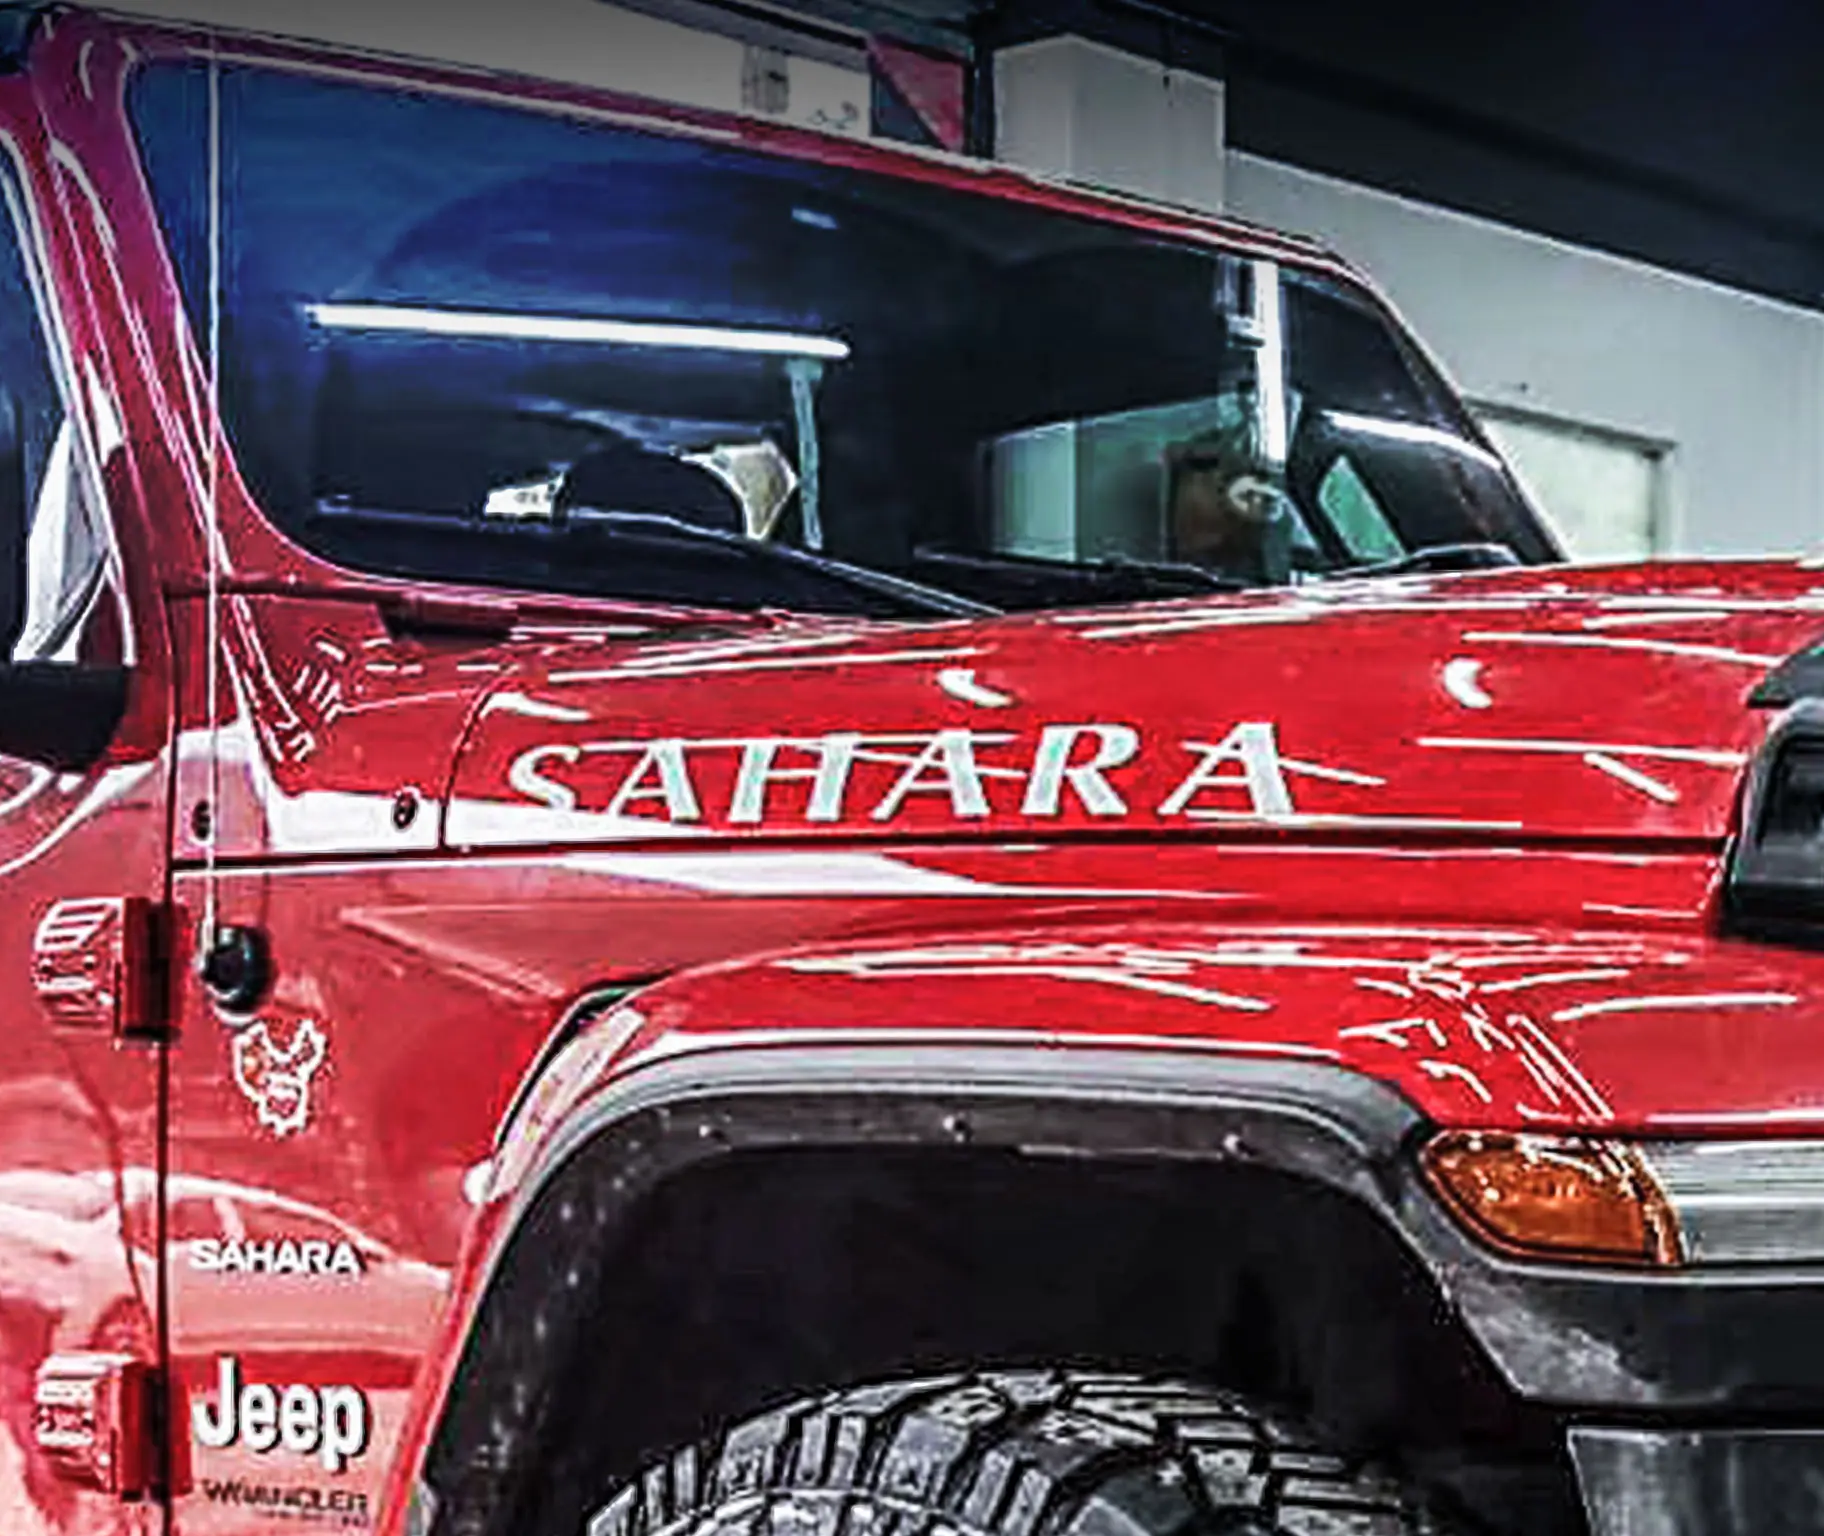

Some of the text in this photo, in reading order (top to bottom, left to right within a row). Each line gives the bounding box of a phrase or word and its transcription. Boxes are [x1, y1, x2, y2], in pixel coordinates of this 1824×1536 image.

[506, 721, 1297, 823] SAHARA
[189, 1238, 362, 1275] SAHARA
[191, 1355, 366, 1471] Jeep
